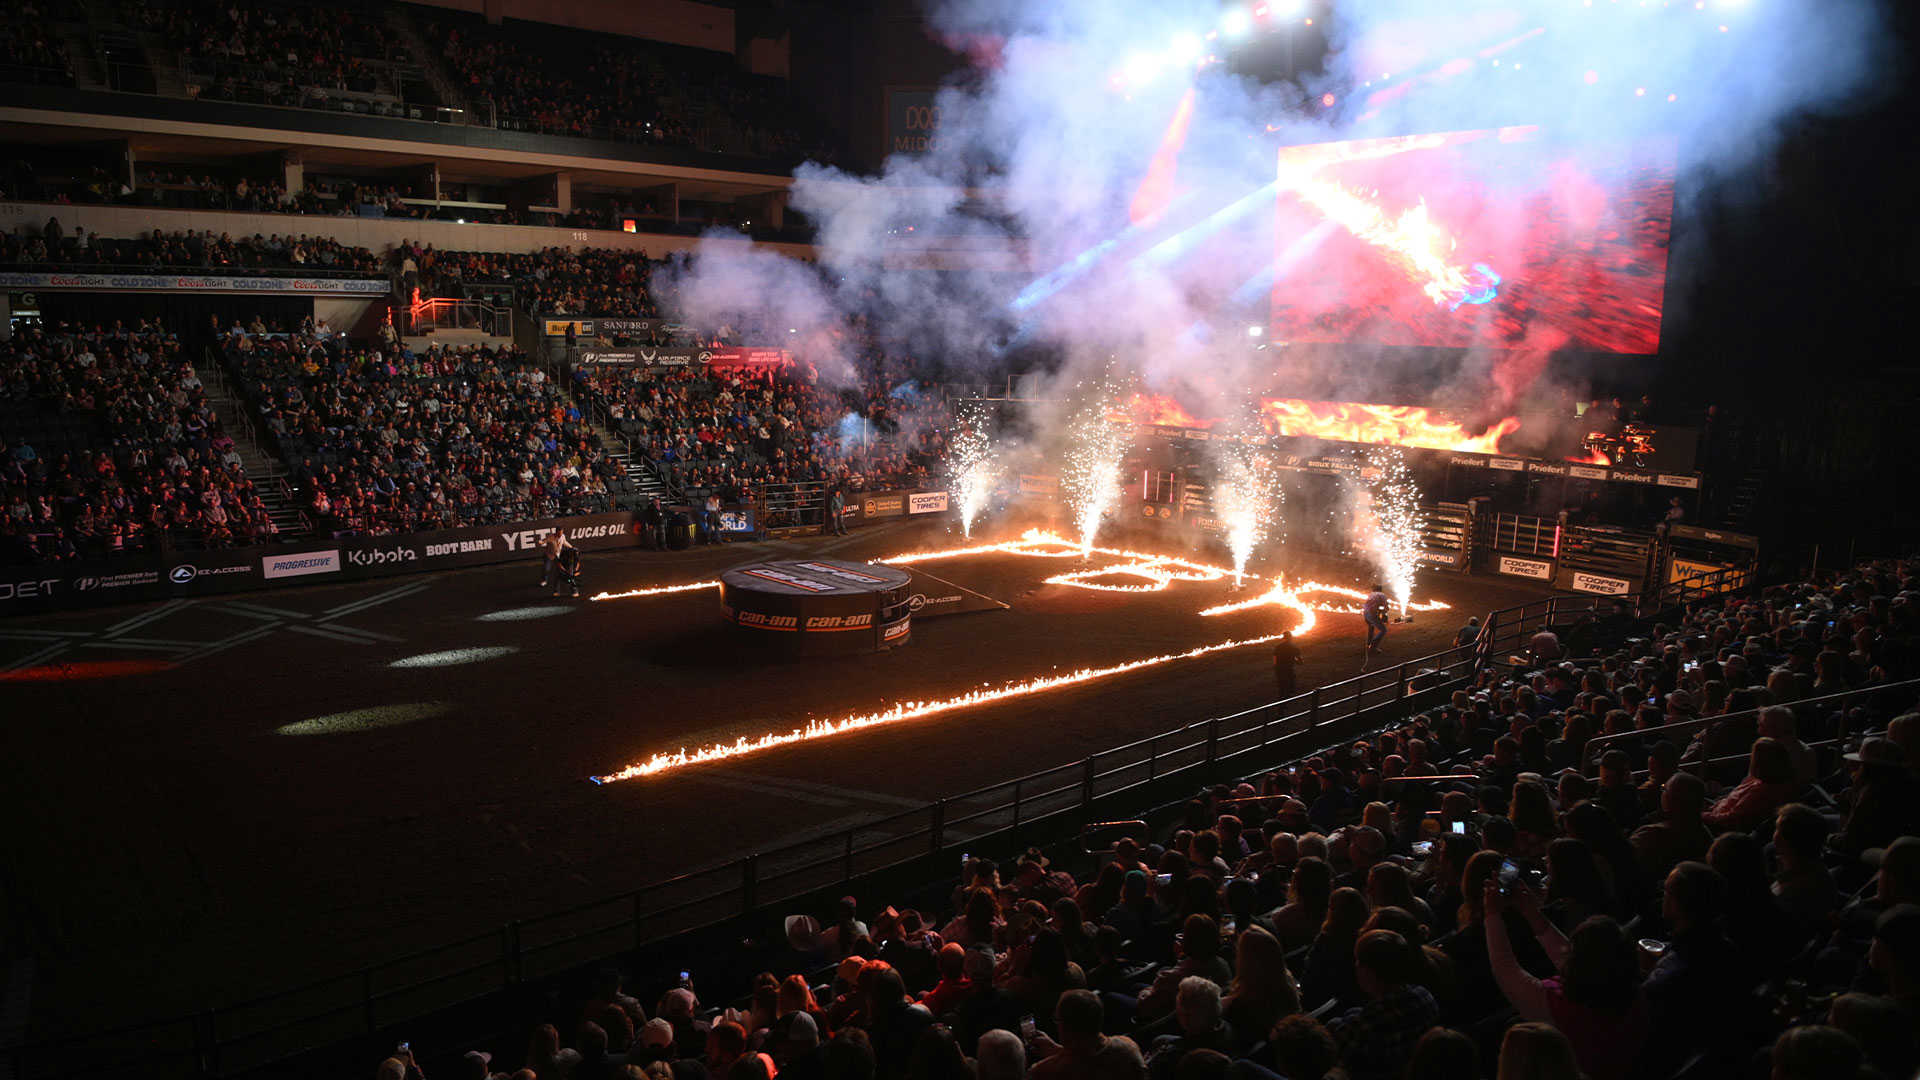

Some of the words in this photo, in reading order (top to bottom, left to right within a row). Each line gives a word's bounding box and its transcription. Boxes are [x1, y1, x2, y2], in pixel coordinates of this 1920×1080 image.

[573, 232, 588, 241] 118
[82, 277, 105, 287] LIGHT
[111, 277, 138, 288] COLD
[205, 279, 227, 288] LIGHT
[232, 279, 257, 289] COLD
[259, 279, 284, 289] ZONE
[318, 281, 339, 290] LIGHT
[343, 282, 365, 291] COLD
[603, 321, 649, 329] SANFORD
[1450, 456, 1484, 467] Priefert
[1528, 462, 1565, 475] Priefert
[1613, 471, 1651, 483] Priefert
[911, 496, 946, 505] COOPER
[916, 502, 940, 510] TIRES
[570, 525, 606, 540] LUCAS
[608, 523, 627, 537] OIL
[502, 527, 557, 552] YET
[426, 543, 458, 557] BOOT
[460, 539, 492, 554] BARN
[348, 546, 416, 567] Kubota
[1429, 553, 1455, 563] WORLD
[273, 557, 332, 571] PROGRESSIVE
[1503, 559, 1547, 570] COOPER
[1508, 566, 1539, 576] TIRES
[1577, 575, 1625, 588] COOPER
[1583, 582, 1616, 594] TIRES
[738, 611, 798, 627] can-am
[806, 614, 872, 628] can-am
